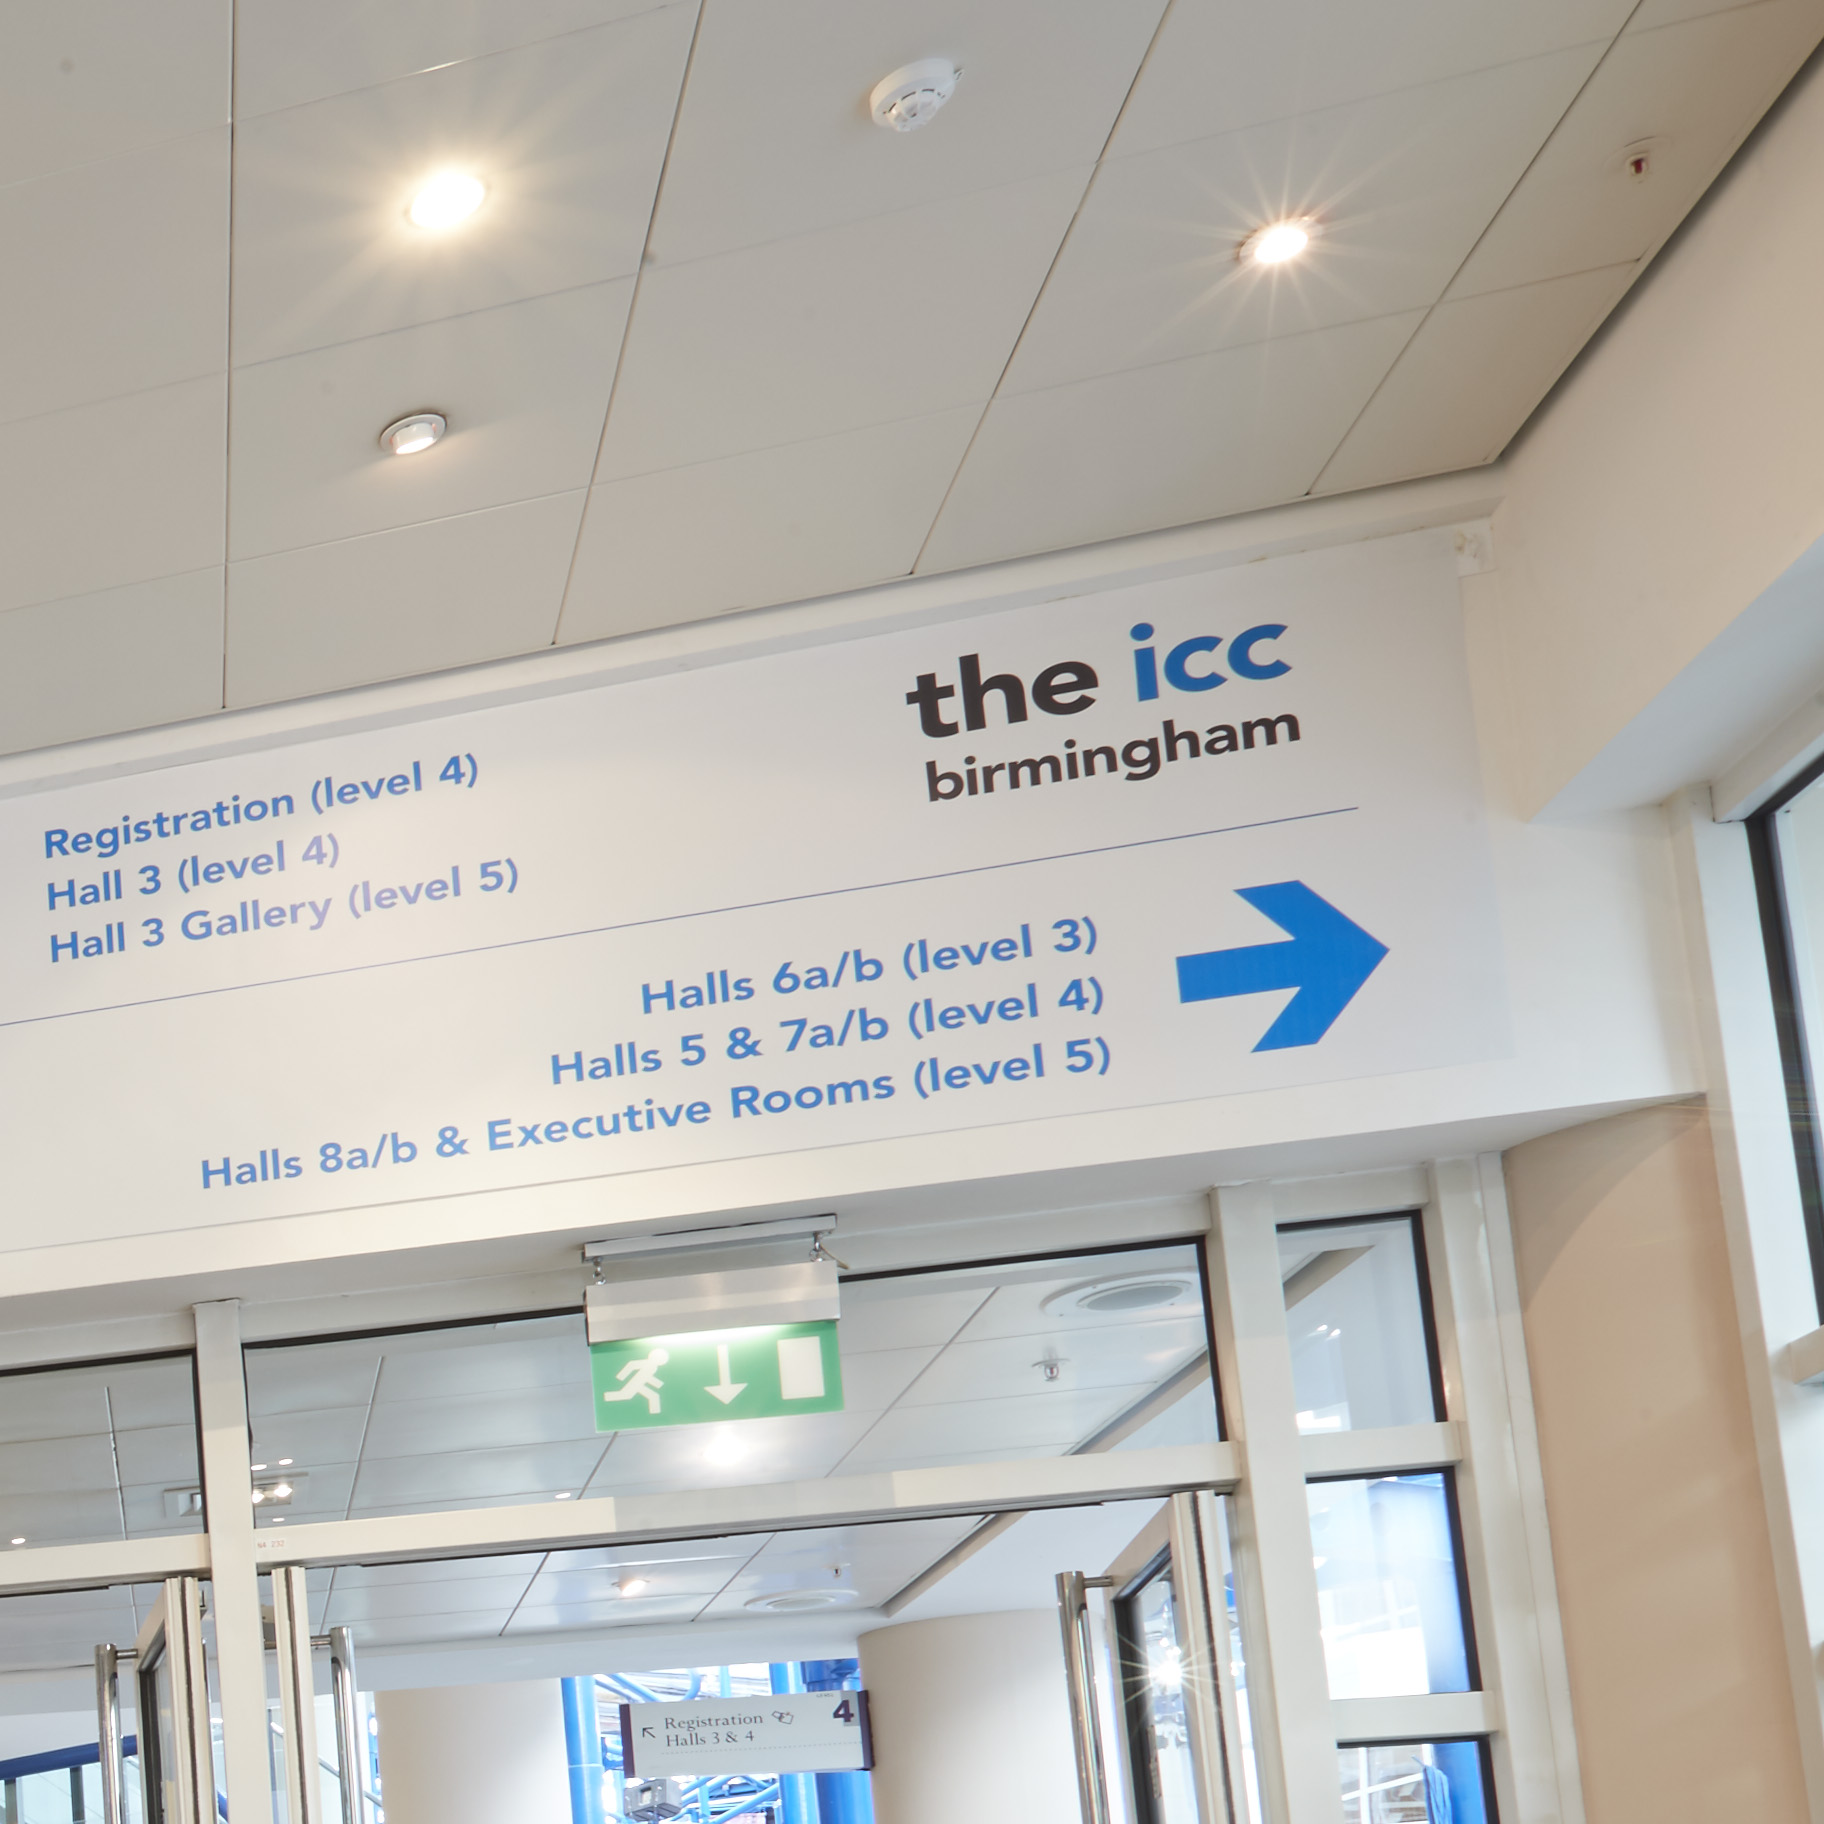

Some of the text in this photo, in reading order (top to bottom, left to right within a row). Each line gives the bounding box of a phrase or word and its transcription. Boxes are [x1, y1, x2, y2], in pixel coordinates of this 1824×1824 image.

[906, 622, 1292, 738] the icc
[44, 753, 478, 859] Registration (level 4)
[925, 713, 1300, 802] birmingham
[47, 833, 339, 911] Hall 3 (level 4)
[50, 858, 518, 963] Hall 3 Gallery (level 5)
[641, 916, 1098, 1014] Halls 6a/b (level 3)
[551, 976, 1104, 1085] Halls 5 & 7a/b (level 4)
[201, 1036, 1111, 1189] Halls 8a/b & Executive Rooms (level 5)
[664, 1713, 764, 1732] Registration
[666, 1729, 755, 1747] Halls 3 & 4
[832, 1699, 855, 1723] 4
